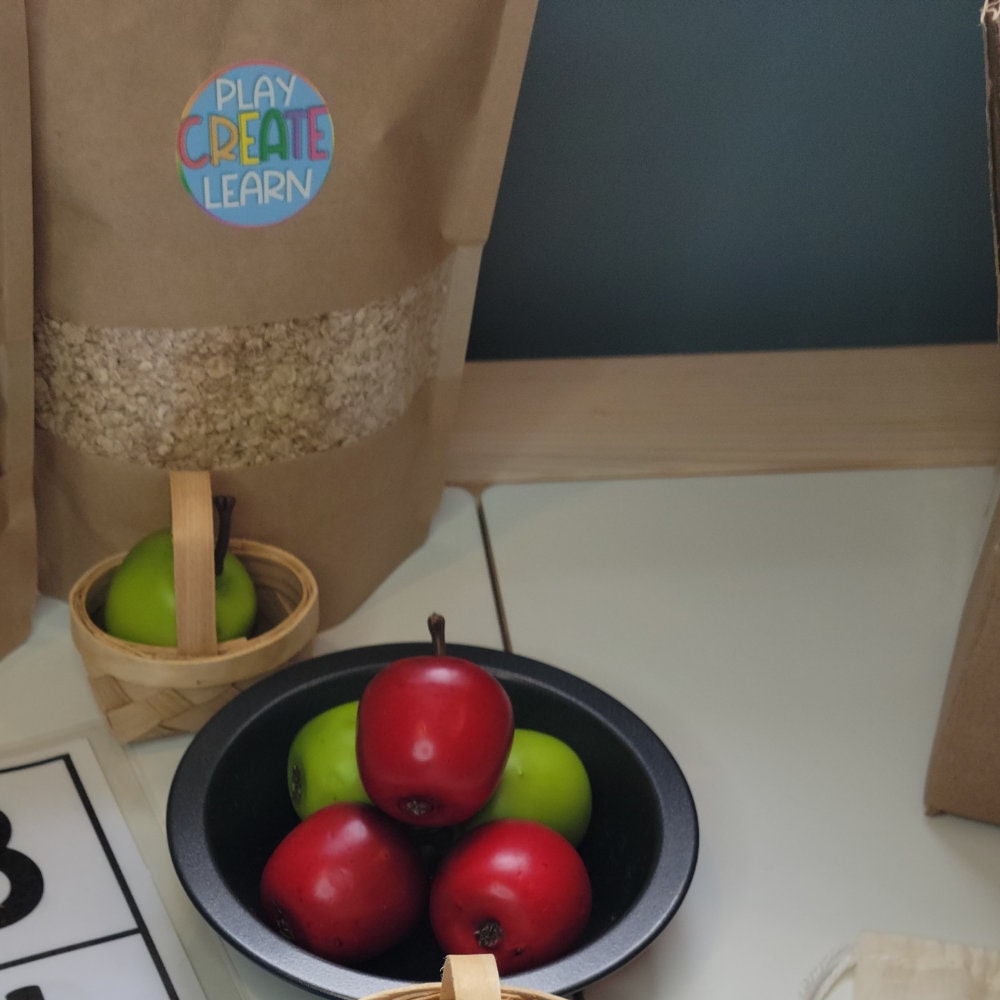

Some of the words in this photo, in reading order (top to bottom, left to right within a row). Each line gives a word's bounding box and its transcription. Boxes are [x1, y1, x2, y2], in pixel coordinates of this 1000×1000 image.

[215, 74, 296, 110] PLAY
[178, 105, 330, 170] CREATE
[203, 168, 313, 210] LEARN
